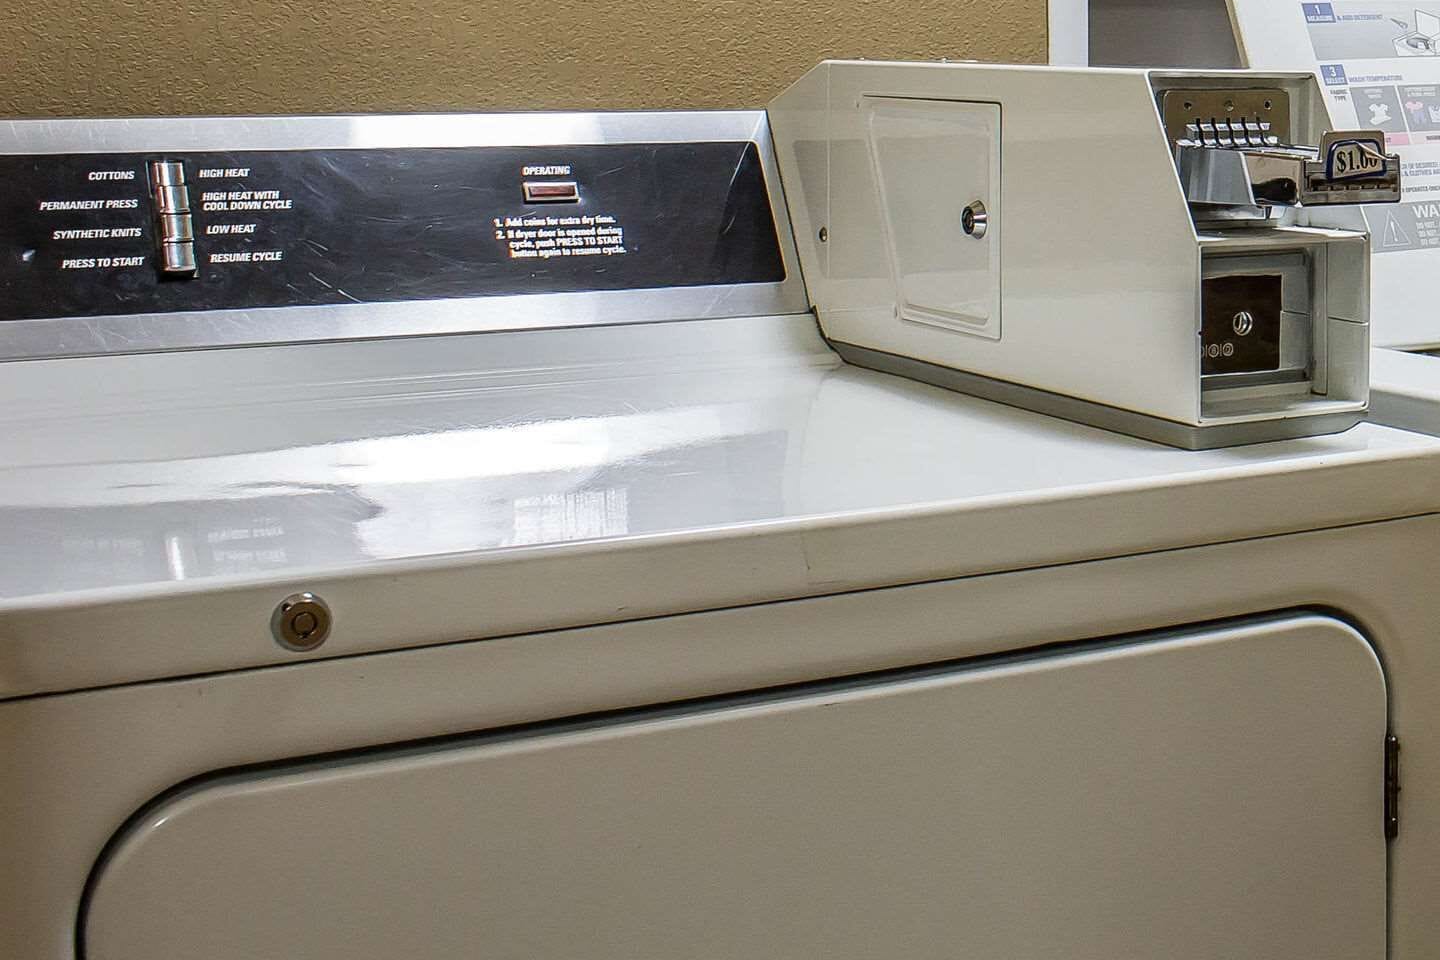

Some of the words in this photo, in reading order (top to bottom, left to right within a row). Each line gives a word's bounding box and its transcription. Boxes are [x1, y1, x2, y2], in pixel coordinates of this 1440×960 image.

[88, 170, 135, 180] COTTONS
[199, 168, 223, 178] HIGH
[224, 168, 250, 177] HEAT
[522, 165, 571, 175] OPERATING
[202, 191, 226, 201] HIGH
[227, 191, 253, 200] HEAT
[253, 190, 280, 200] WITH
[40, 200, 104, 210] PERMANENT
[105, 199, 138, 208] PRESS
[203, 202, 229, 211] COOL
[230, 201, 261, 210] DOWN
[262, 200, 292, 209] CYCLE
[504, 217, 522, 227] Add
[546, 216, 558, 225] for
[559, 216, 580, 225] extra
[581, 215, 594, 226] dry
[53, 229, 110, 240] SYNTHETIC
[111, 228, 142, 237] KNITS
[206, 224, 230, 234] LOW
[230, 224, 256, 233] HEAT
[566, 226, 595, 238] opened
[596, 226, 622, 236] during
[535, 238, 556, 249] push
[556, 236, 583, 246] PRESS
[583, 236, 595, 246] TO
[596, 235, 623, 245] START
[210, 252, 252, 263] RESUME
[252, 251, 283, 261] CYCLE
[562, 247, 570, 256] to
[571, 247, 601, 256] resume
[62, 259, 96, 269] PRESS
[96, 258, 111, 267] TO
[111, 257, 145, 266] START
